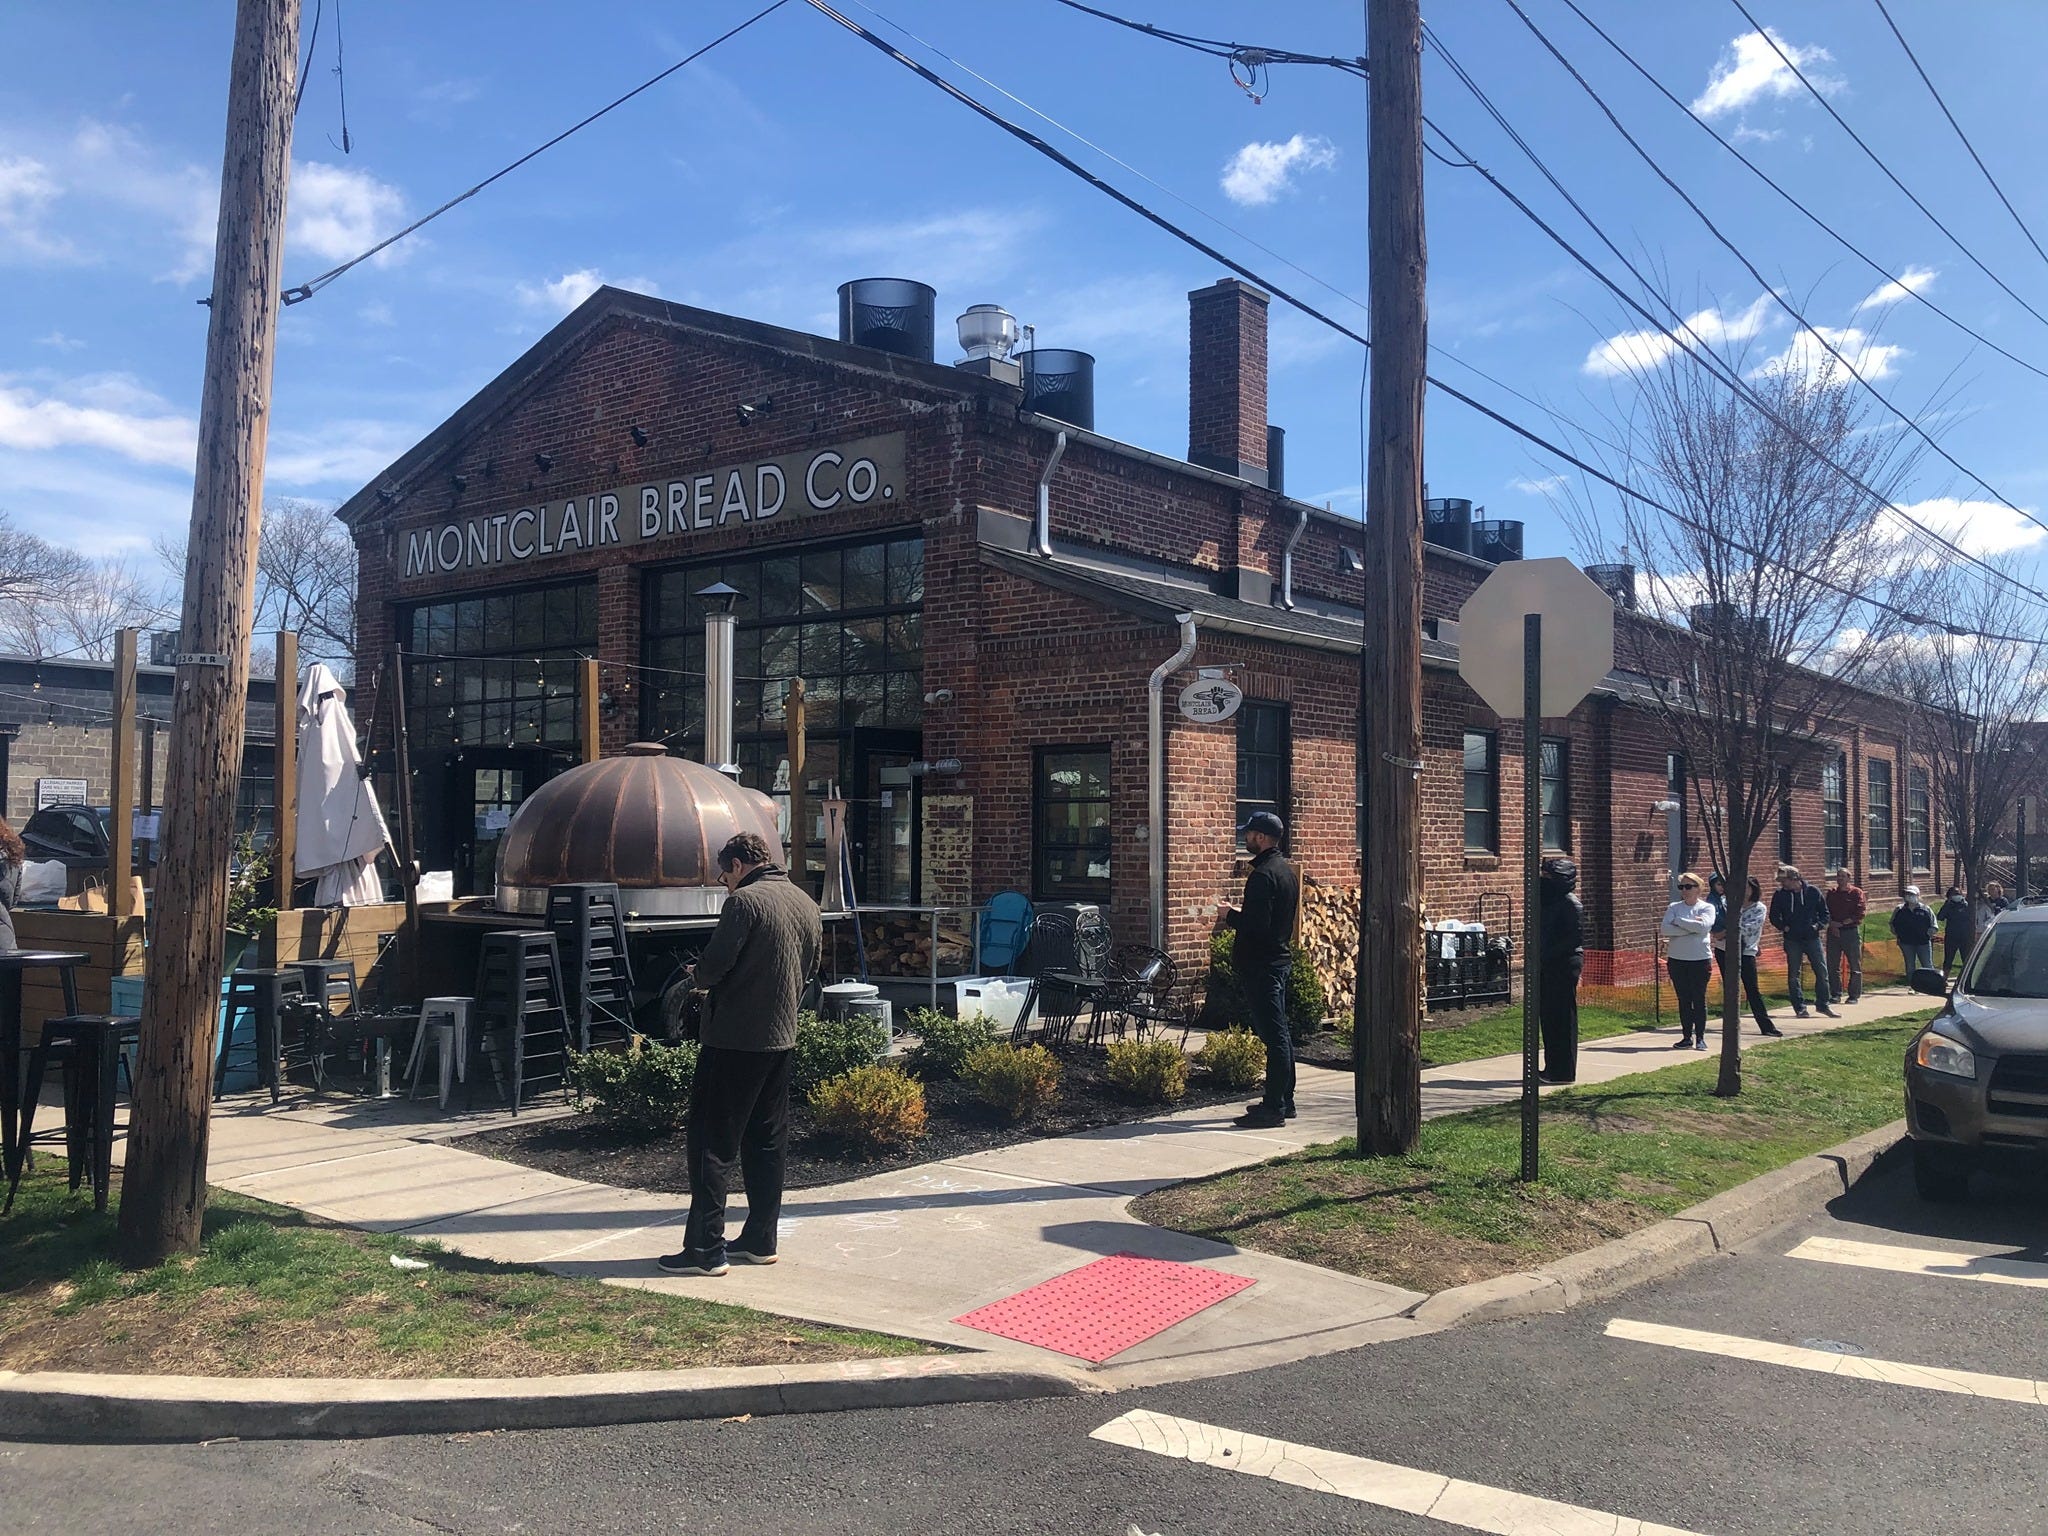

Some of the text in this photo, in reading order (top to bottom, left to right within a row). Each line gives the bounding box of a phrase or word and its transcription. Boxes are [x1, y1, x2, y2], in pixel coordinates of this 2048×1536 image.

[405, 450, 894, 577] MONTCLAIR BREAD Co.
